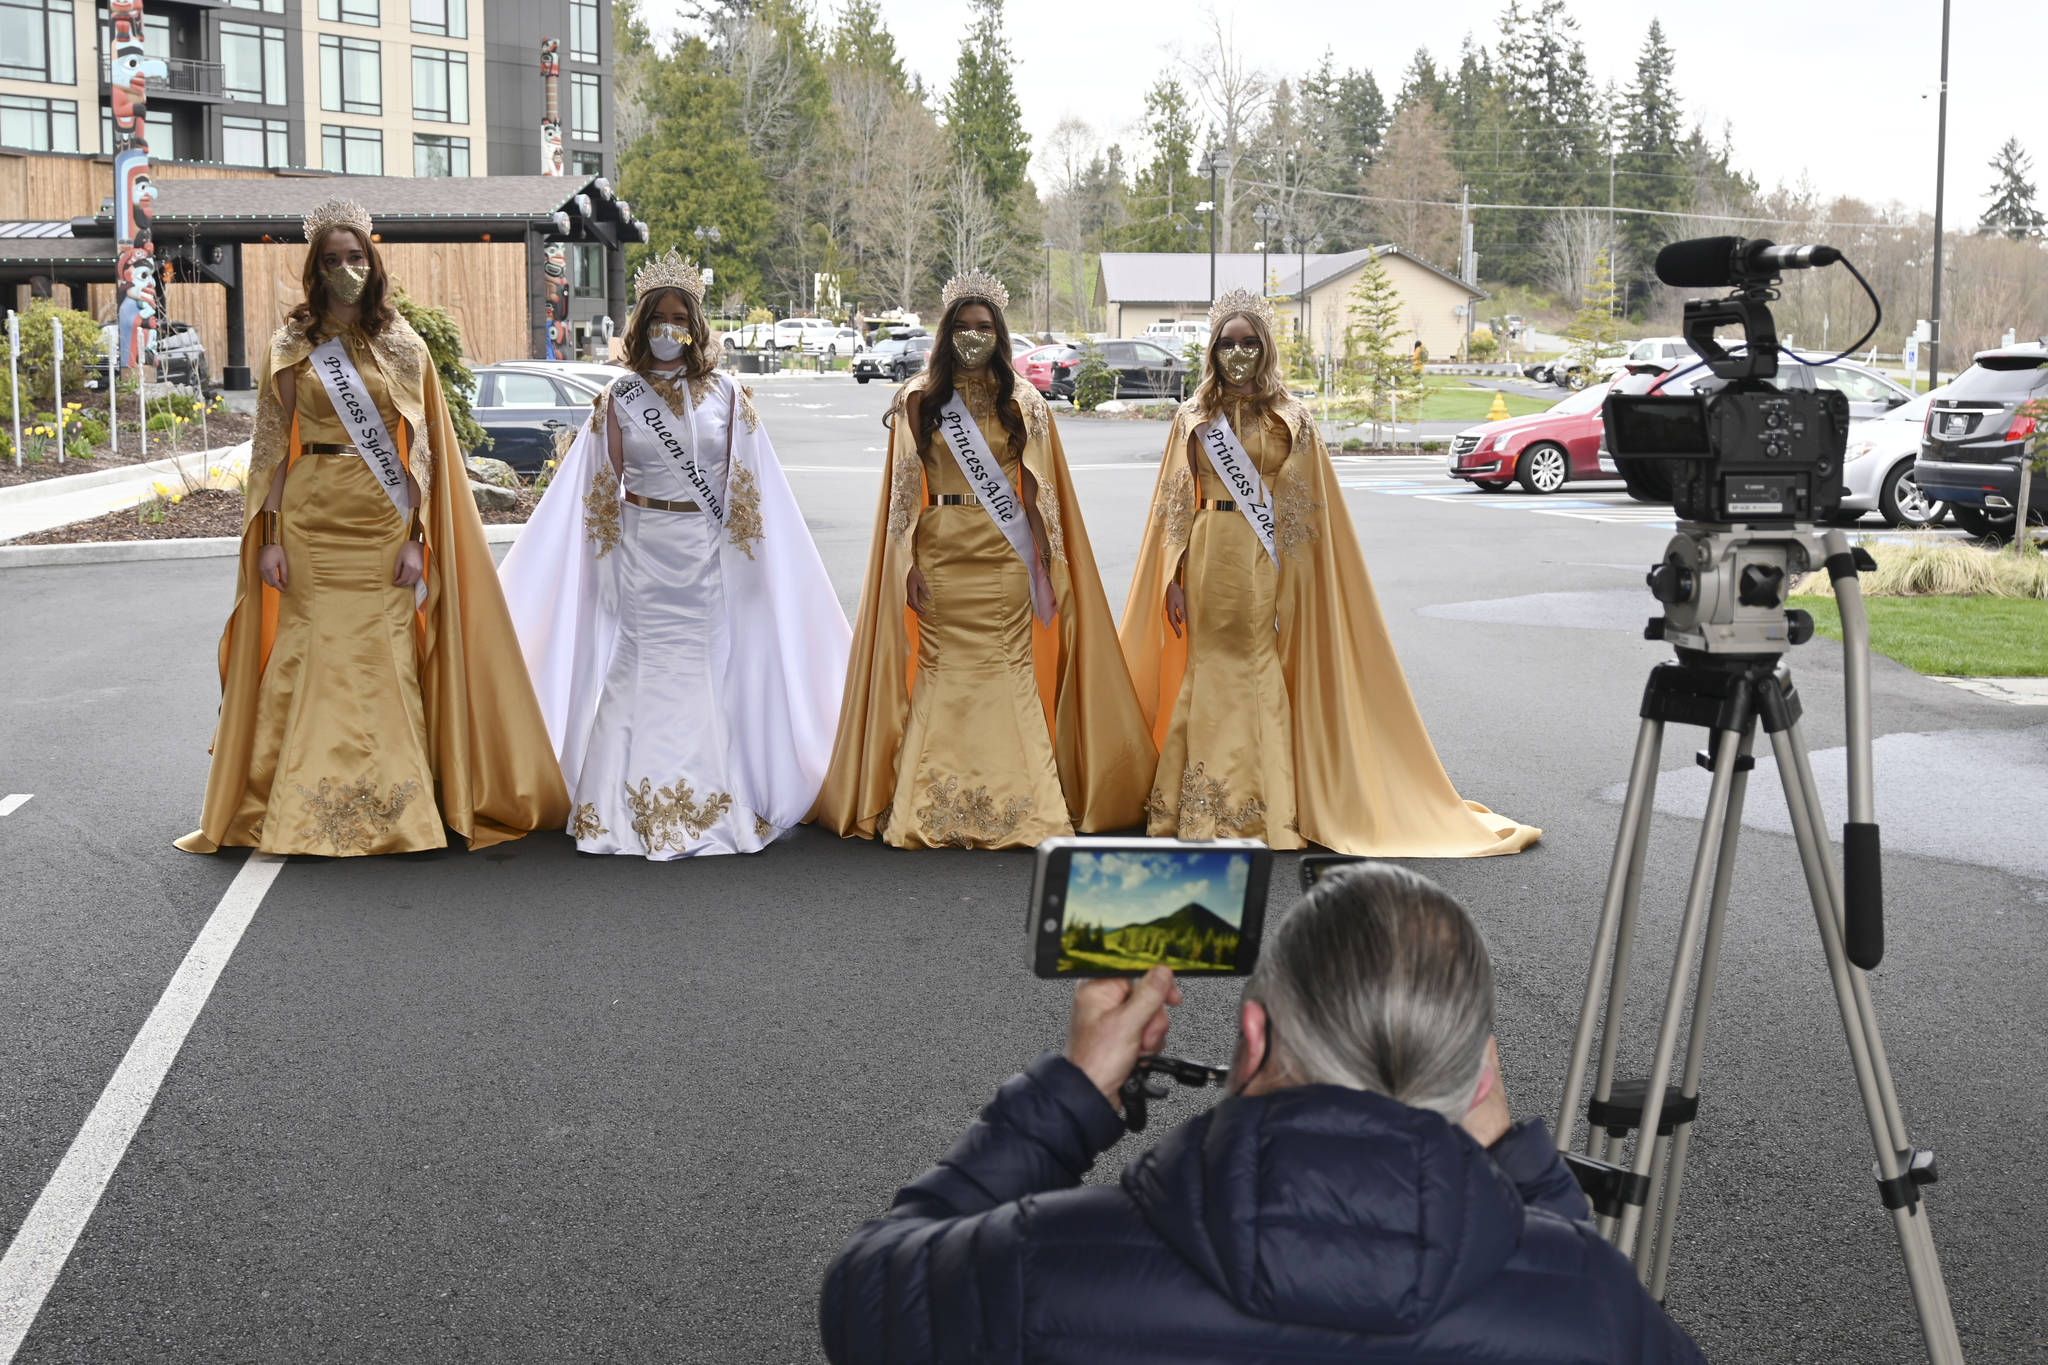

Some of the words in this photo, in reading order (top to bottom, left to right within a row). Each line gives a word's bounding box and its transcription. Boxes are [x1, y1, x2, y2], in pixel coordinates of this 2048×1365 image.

[323, 356, 367, 424] Princess
[361, 427, 401, 486] Sydney
[624, 386, 646, 405] 2021
[643, 407, 685, 460] Queen
[942, 411, 988, 481] Princess
[981, 481, 1013, 523] Allie
[1207, 428, 1254, 497] Princess
